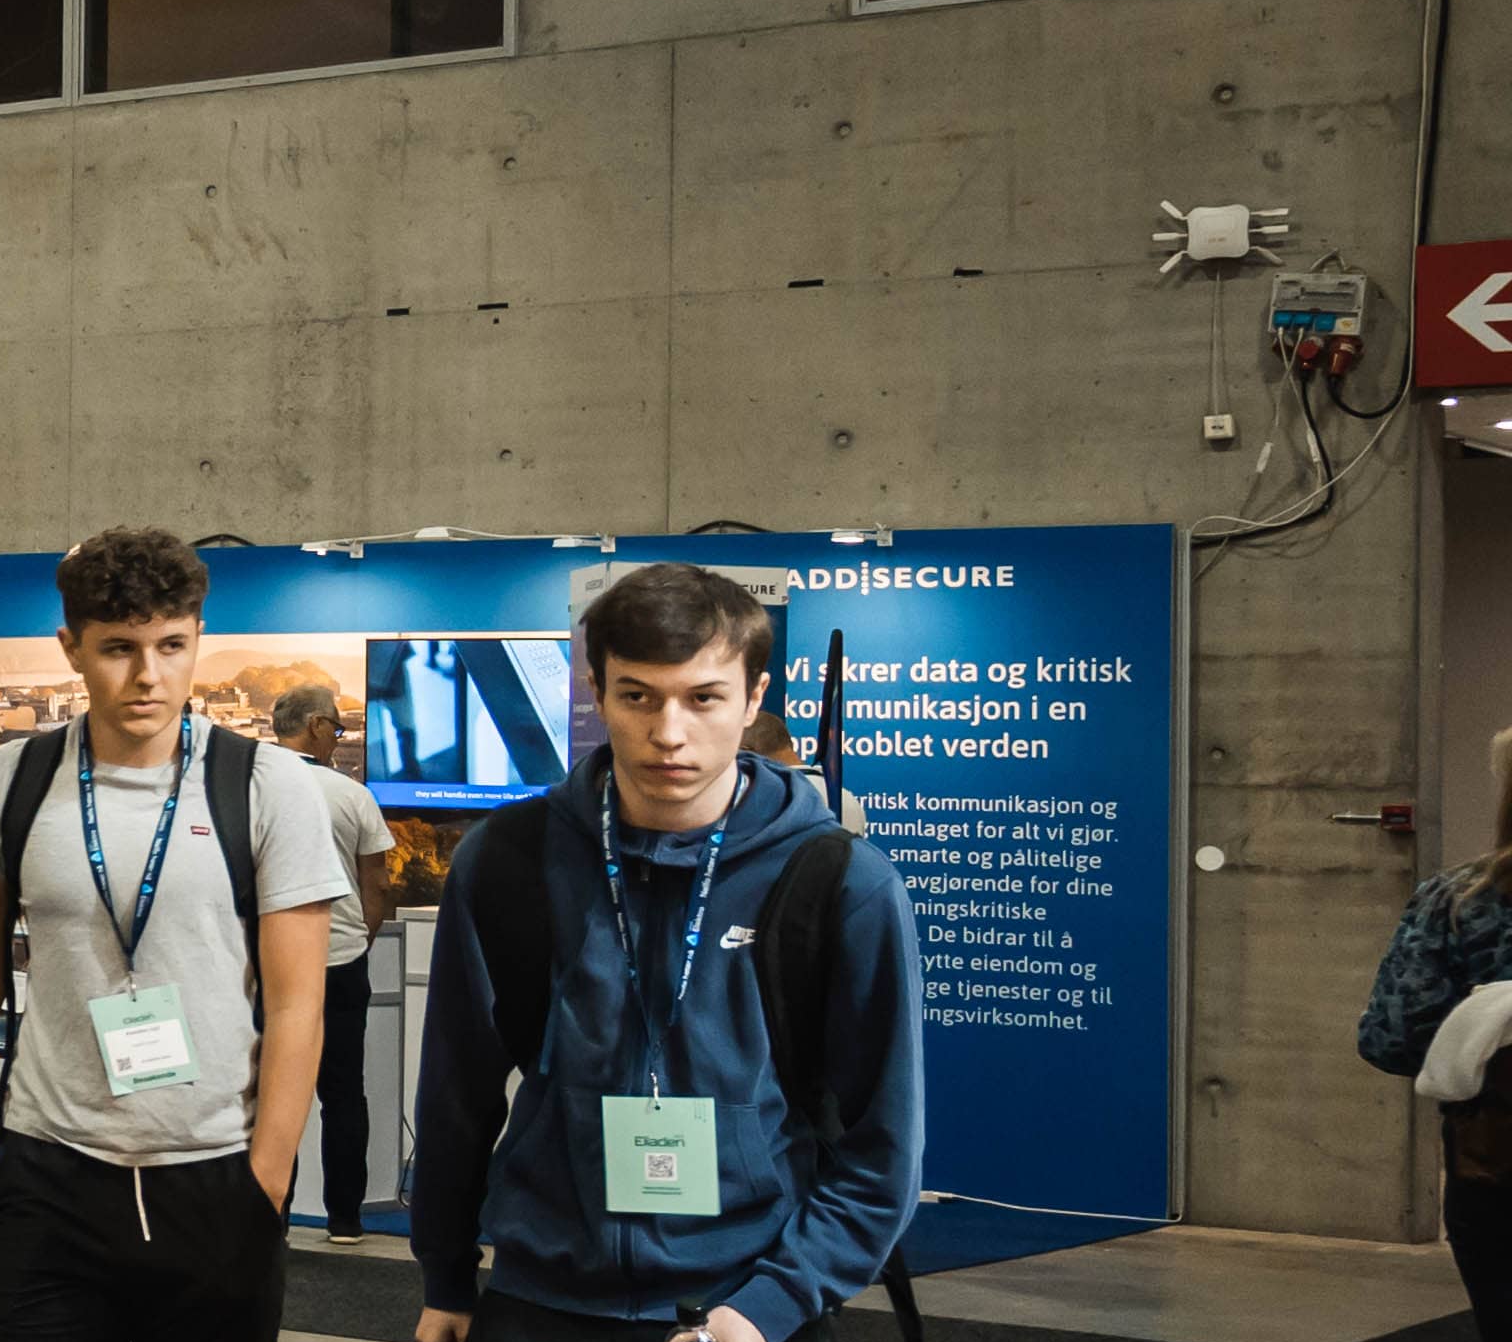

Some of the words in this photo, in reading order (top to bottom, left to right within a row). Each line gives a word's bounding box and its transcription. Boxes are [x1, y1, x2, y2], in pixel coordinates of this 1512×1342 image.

[785, 656, 809, 683] Vi
[818, 656, 902, 683] skrer
[910, 657, 978, 683] data
[987, 662, 1027, 689] og
[1037, 656, 1132, 683] kritisk
[1031, 695, 1037, 720] i
[1048, 699, 1087, 721] en
[943, 732, 1048, 758] verden
[915, 793, 1083, 818] kommunikasjon
[1090, 801, 1117, 819] og
[976, 821, 1005, 839] for
[1012, 822, 1040, 840] alt
[1046, 824, 1064, 840] vi
[1070, 826, 1119, 846] gjør.
[889, 847, 961, 864] smarte
[967, 850, 994, 869] og
[1000, 848, 1102, 873] pålitelige
[905, 873, 1024, 894] avgjørende
[1030, 875, 1059, 894] for
[1066, 877, 1113, 896] dine
[914, 899, 1047, 921] ningskritiske
[928, 925, 956, 943] De
[964, 926, 1026, 946] bidrar
[1033, 929, 1054, 949] til
[1060, 930, 1073, 949] å
[920, 954, 964, 974] ytte
[970, 954, 1063, 976] eiendom
[1070, 962, 1097, 981] og
[957, 980, 1051, 1001] tjenester
[1057, 989, 1084, 1007] og
[1090, 987, 1113, 1005] til
[923, 1004, 1088, 1031] ingsvirksomhet.
